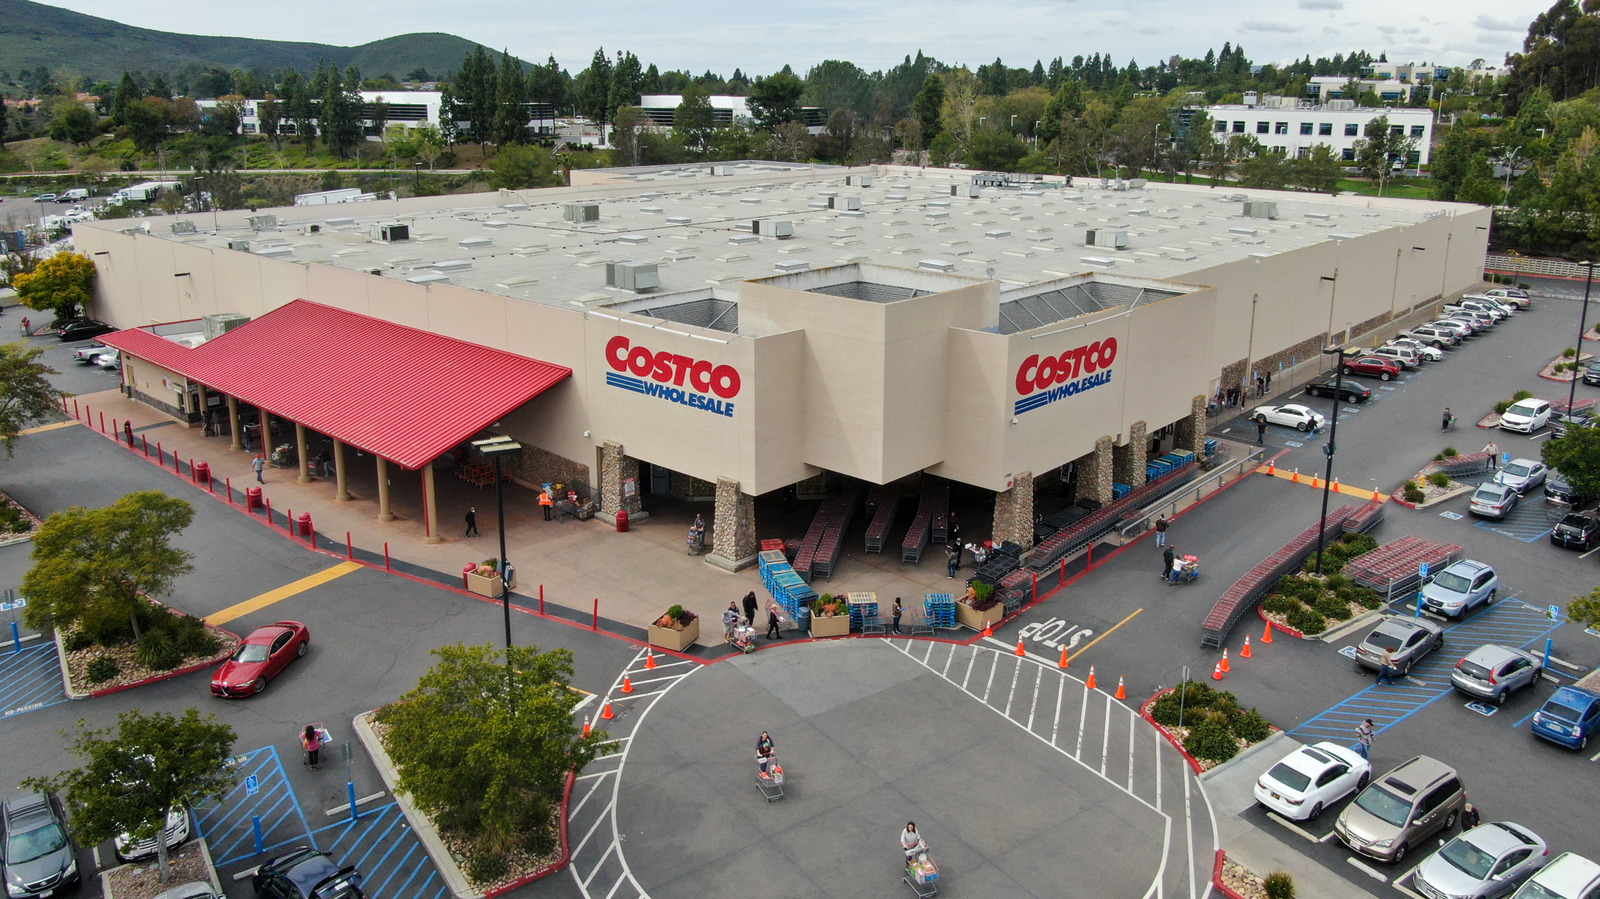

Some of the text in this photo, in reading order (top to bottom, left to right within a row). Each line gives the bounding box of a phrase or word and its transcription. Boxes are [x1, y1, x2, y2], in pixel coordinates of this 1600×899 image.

[605, 335, 741, 399] COSTCO
[1015, 336, 1118, 396] COSTCO
[643, 381, 735, 418] WHOLESALE
[1047, 369, 1112, 404] WHOLESALE
[1018, 617, 1093, 651] STOP
